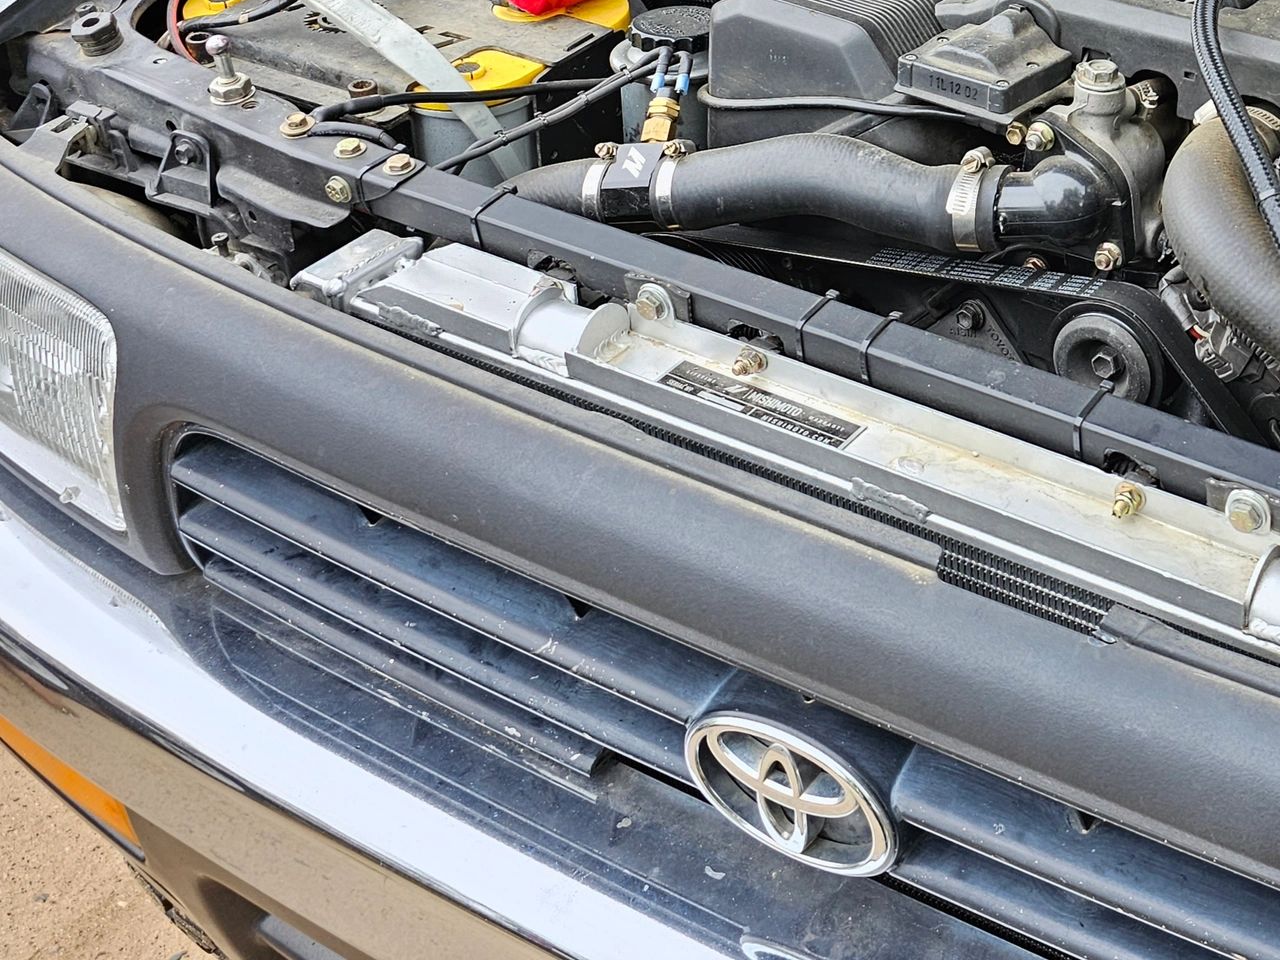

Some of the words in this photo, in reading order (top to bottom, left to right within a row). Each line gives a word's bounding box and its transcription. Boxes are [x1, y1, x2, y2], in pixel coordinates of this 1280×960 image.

[950, 81, 961, 95] 12
[749, 390, 803, 417] MISHIMOTO
[760, 414, 831, 445] MISHIMOTO.COM
